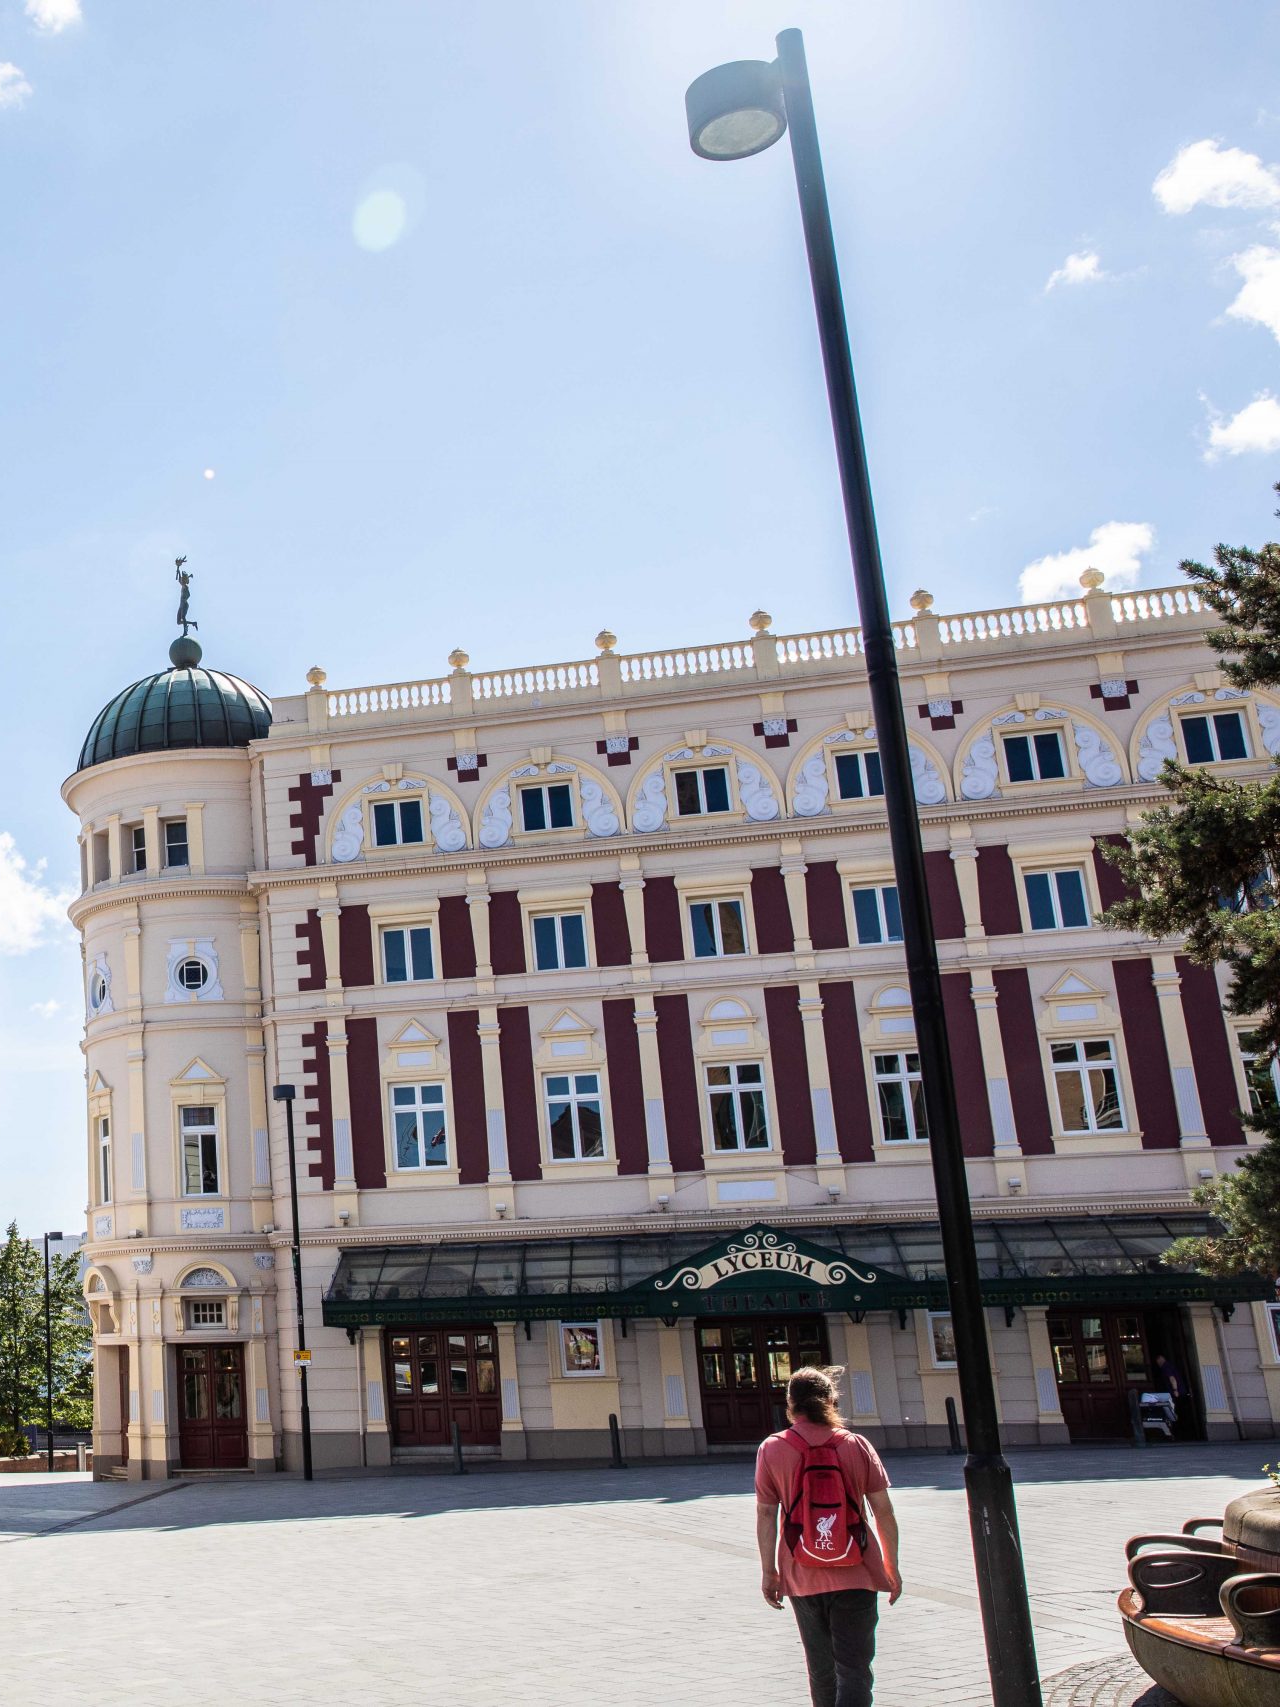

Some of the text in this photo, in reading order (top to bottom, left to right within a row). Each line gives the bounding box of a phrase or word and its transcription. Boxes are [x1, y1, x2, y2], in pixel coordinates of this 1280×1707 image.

[711, 1252, 815, 1279] LYCEUM
[702, 1292, 832, 1312] THEATRE
[815, 1542, 835, 1550] L.F.C.
